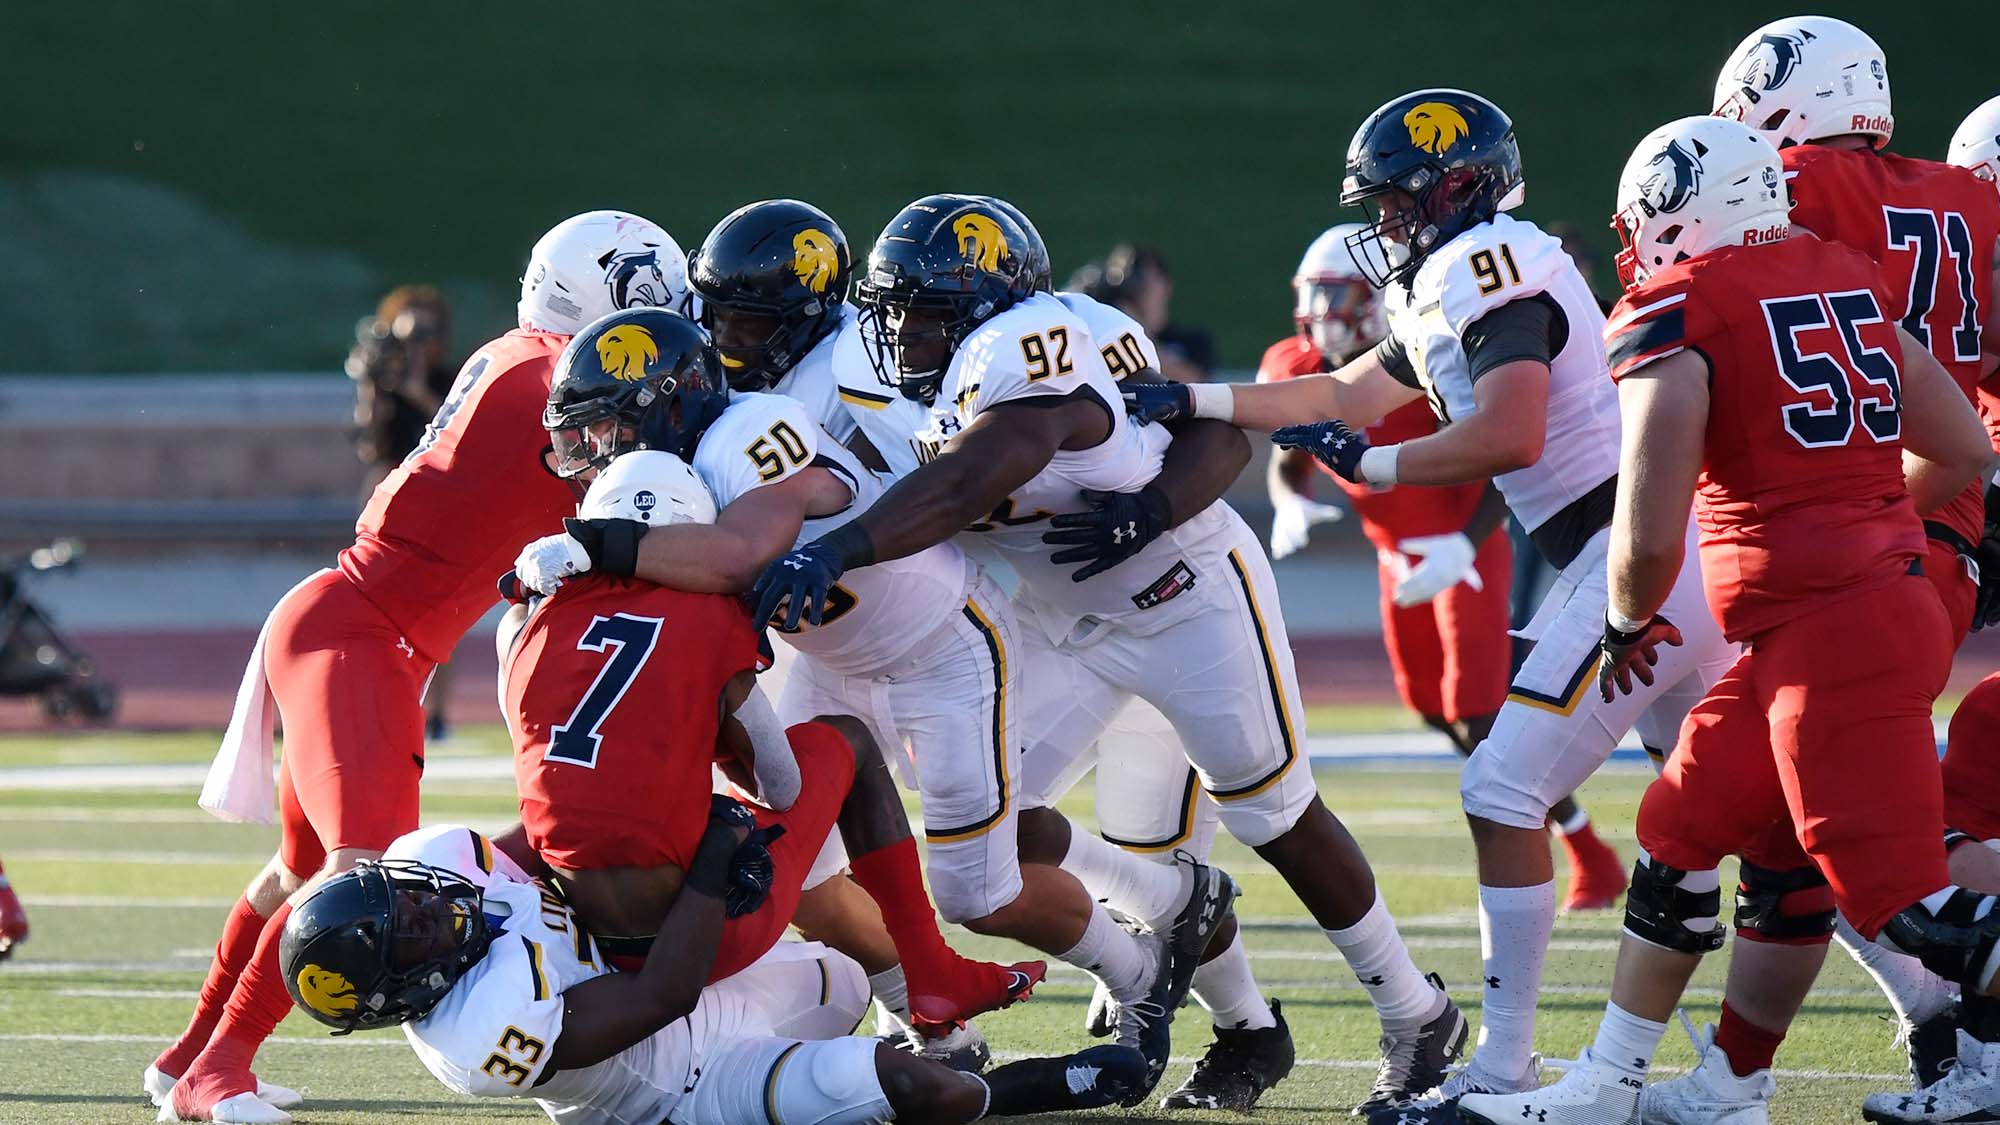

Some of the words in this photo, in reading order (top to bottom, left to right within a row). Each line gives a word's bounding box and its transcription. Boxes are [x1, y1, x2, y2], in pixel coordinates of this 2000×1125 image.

[1469, 243, 1522, 297] 91
[1883, 205, 1982, 362] 71
[1019, 325, 1073, 384] 92
[1100, 331, 1149, 382] 90
[1760, 289, 1903, 448] 55
[744, 420, 809, 484] 50
[635, 494, 655, 507] LEO
[544, 611, 665, 769] 7
[480, 1025, 545, 1088] 33
